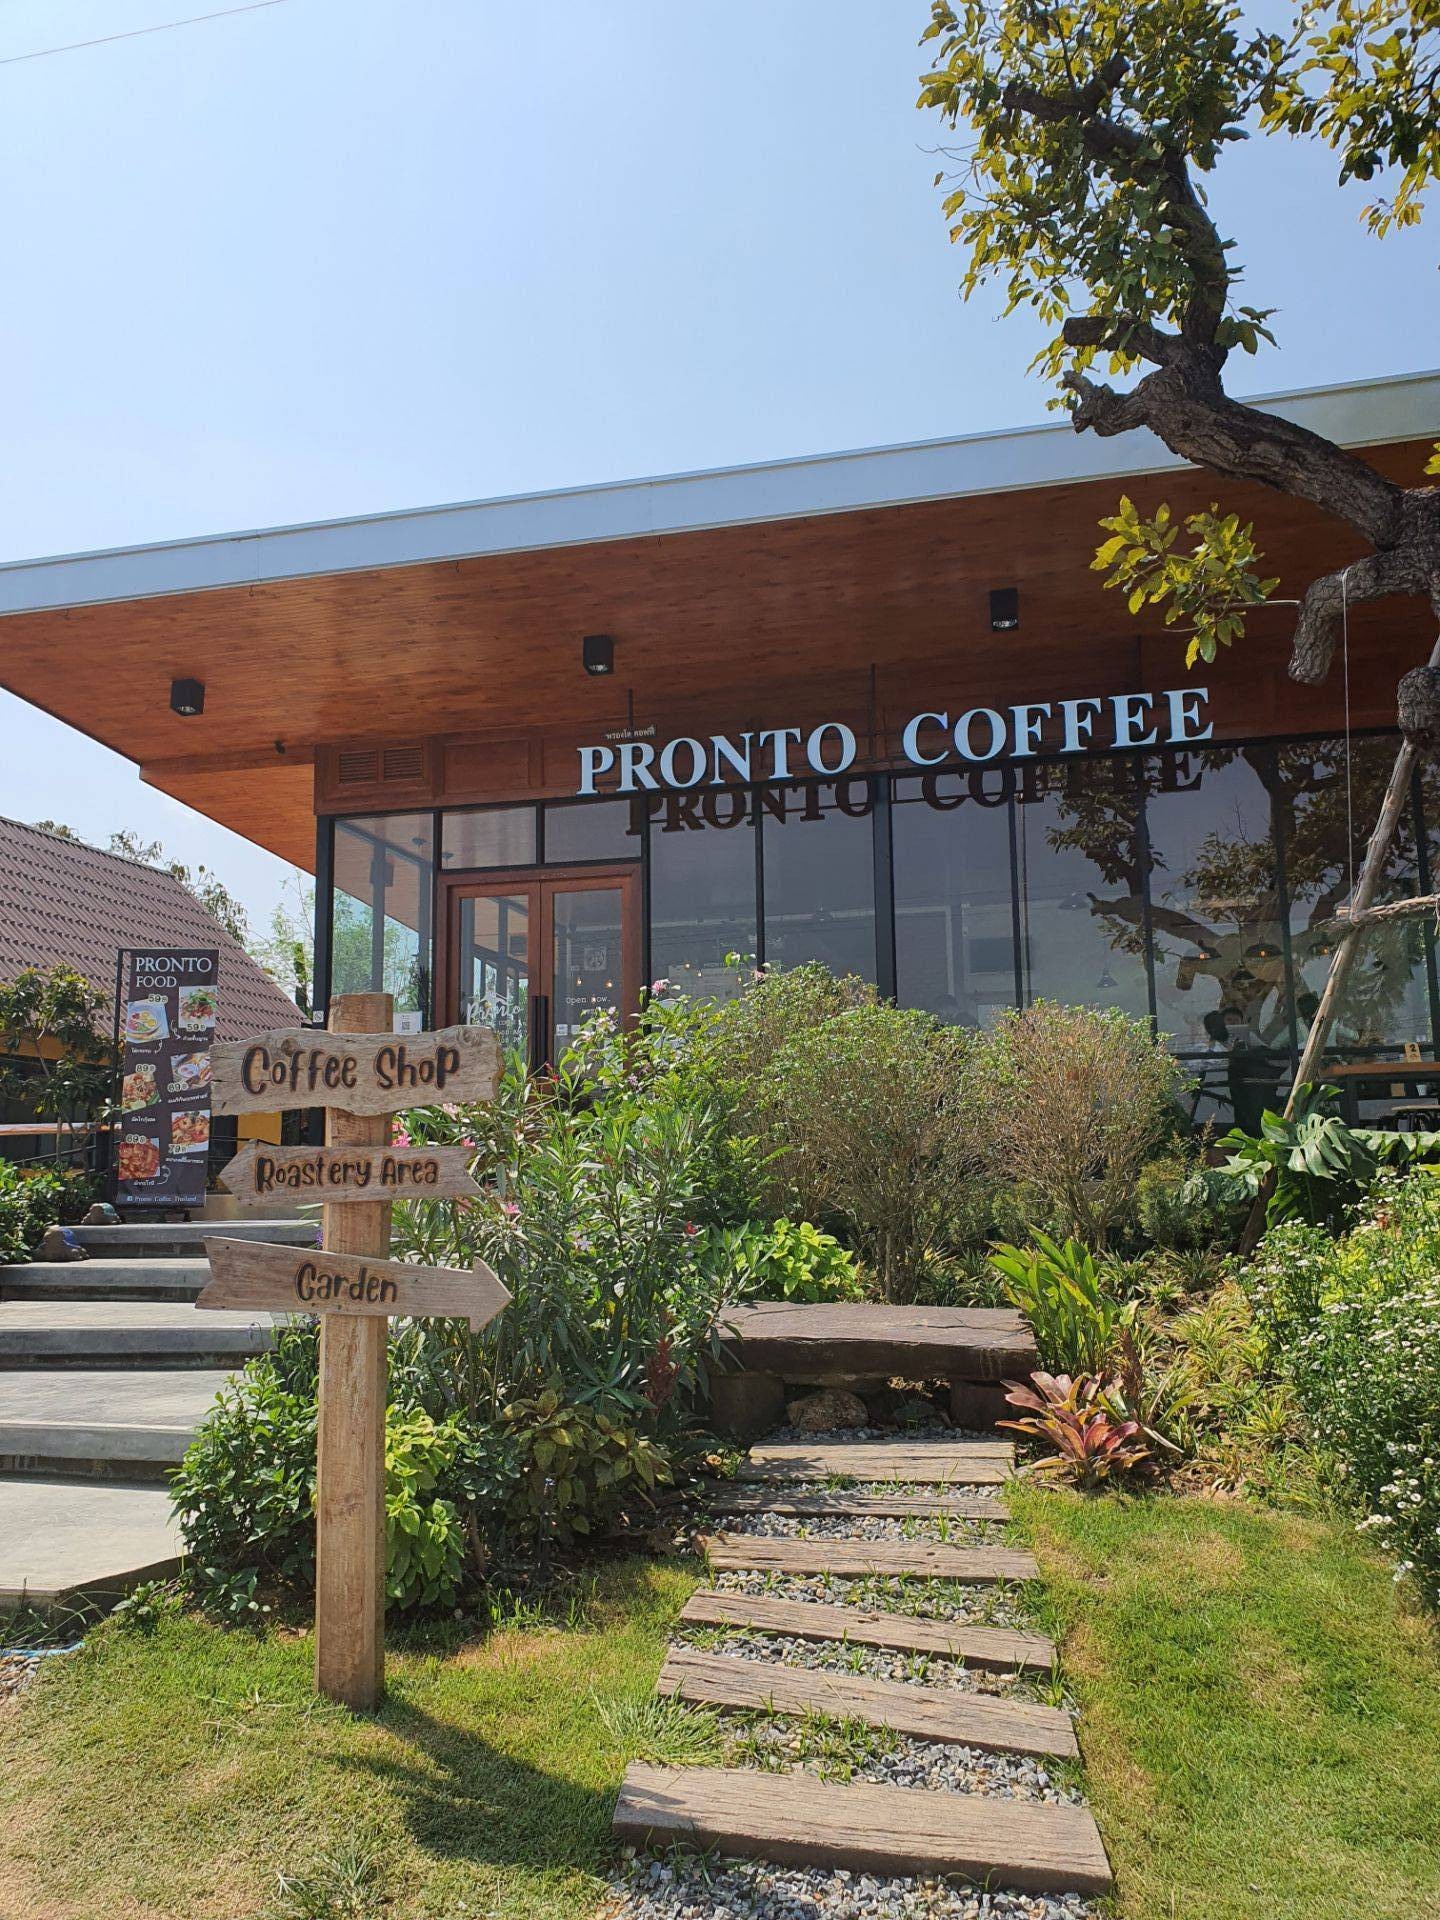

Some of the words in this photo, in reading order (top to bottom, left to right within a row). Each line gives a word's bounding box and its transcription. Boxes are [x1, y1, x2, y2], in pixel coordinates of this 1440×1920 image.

[576, 723, 857, 795] PRONTO
[902, 687, 1214, 765] COFFEE
[135, 957, 212, 972] PRONTO
[136, 976, 177, 987] FOOD
[242, 1046, 358, 1095] Coffee
[375, 1045, 461, 1090] Shop
[255, 1156, 371, 1194] Roastery
[380, 1156, 439, 1187] Area
[295, 1263, 398, 1303] Garden
